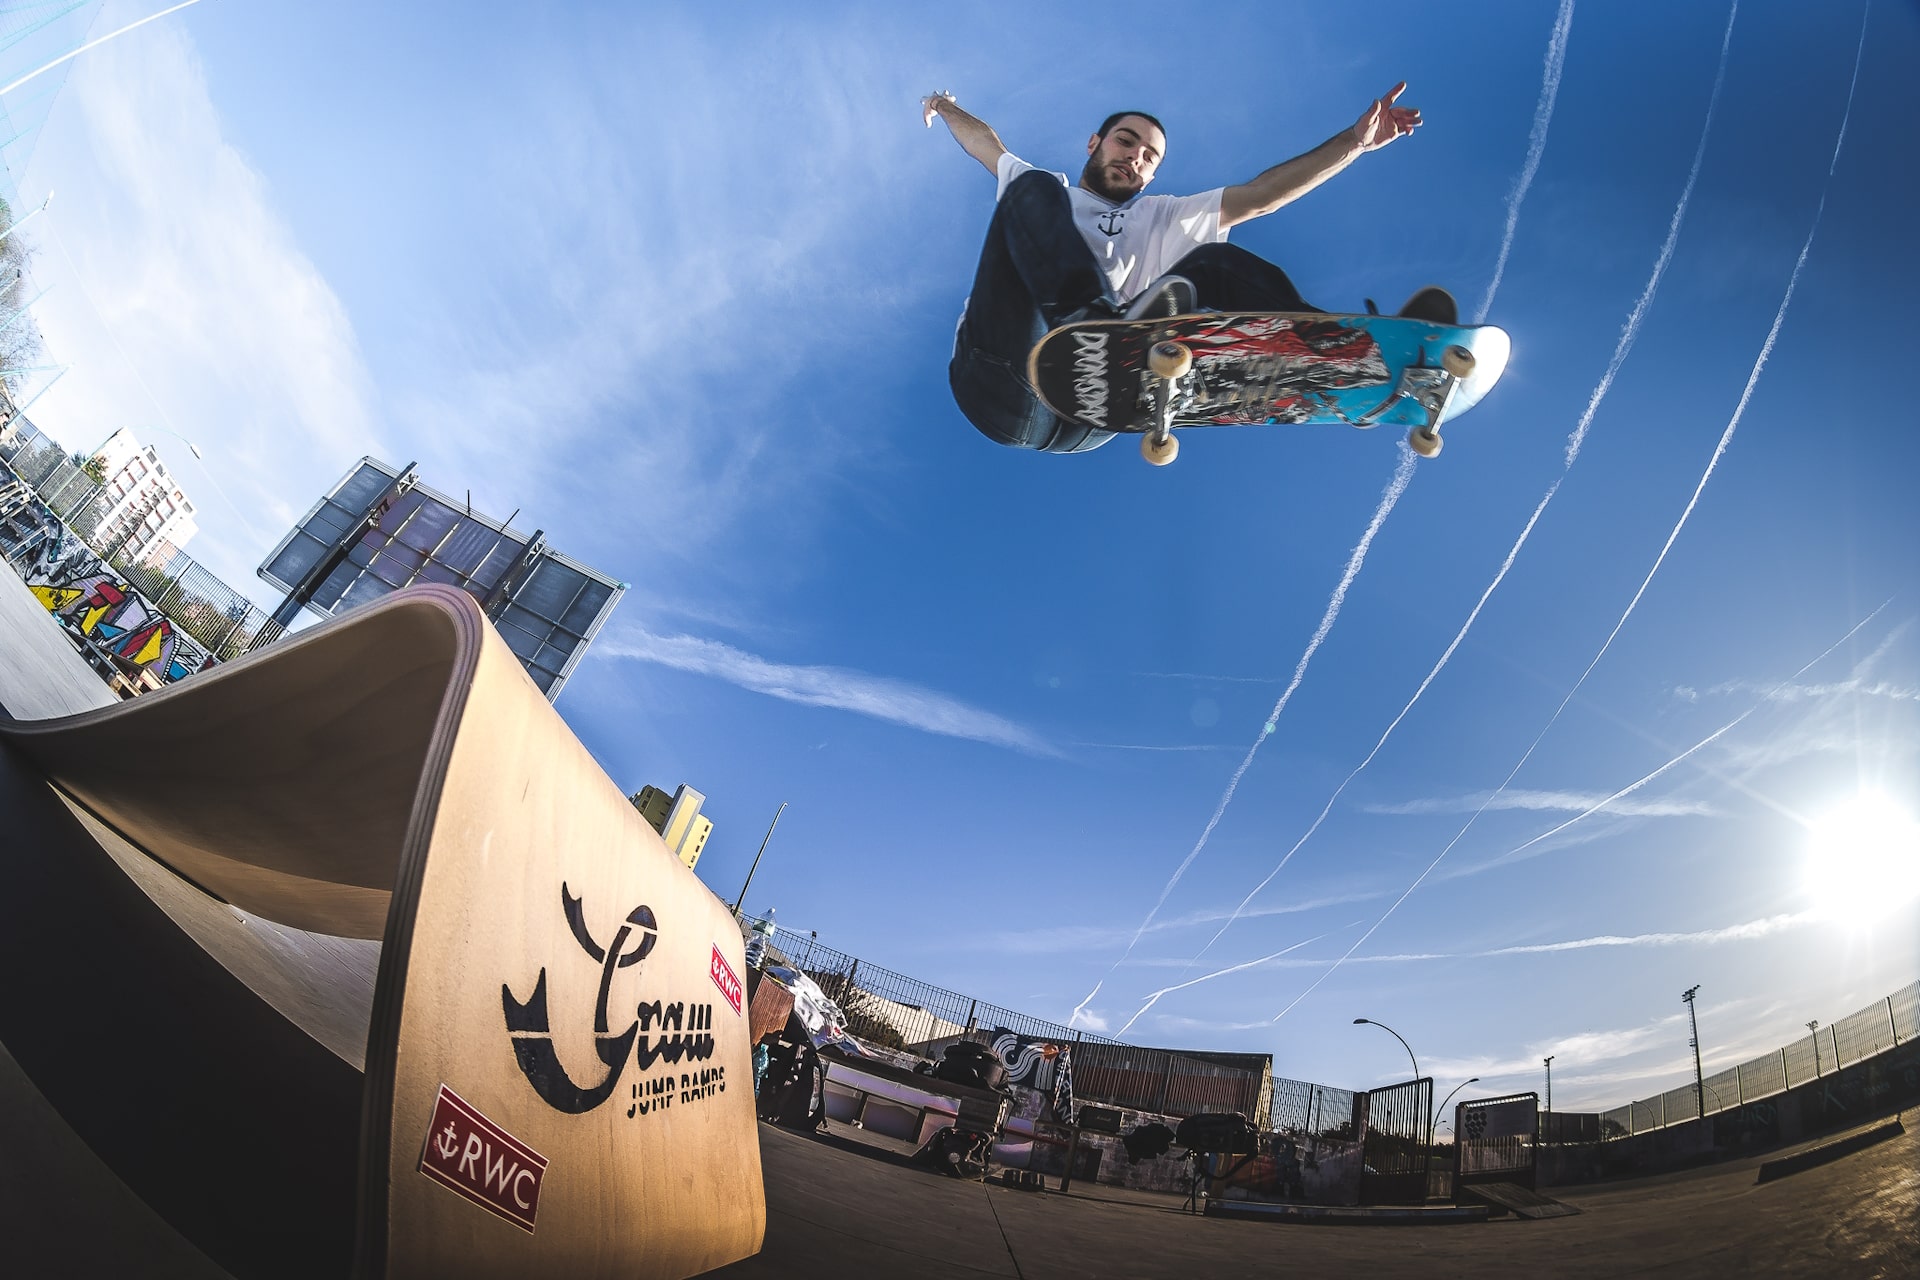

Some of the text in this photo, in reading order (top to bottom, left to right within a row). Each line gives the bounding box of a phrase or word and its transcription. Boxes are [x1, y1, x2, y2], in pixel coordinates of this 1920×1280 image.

[719, 963, 741, 1007] RWC
[627, 1066, 726, 1119] JUMP RAMPS
[458, 1131, 536, 1210] RWC
